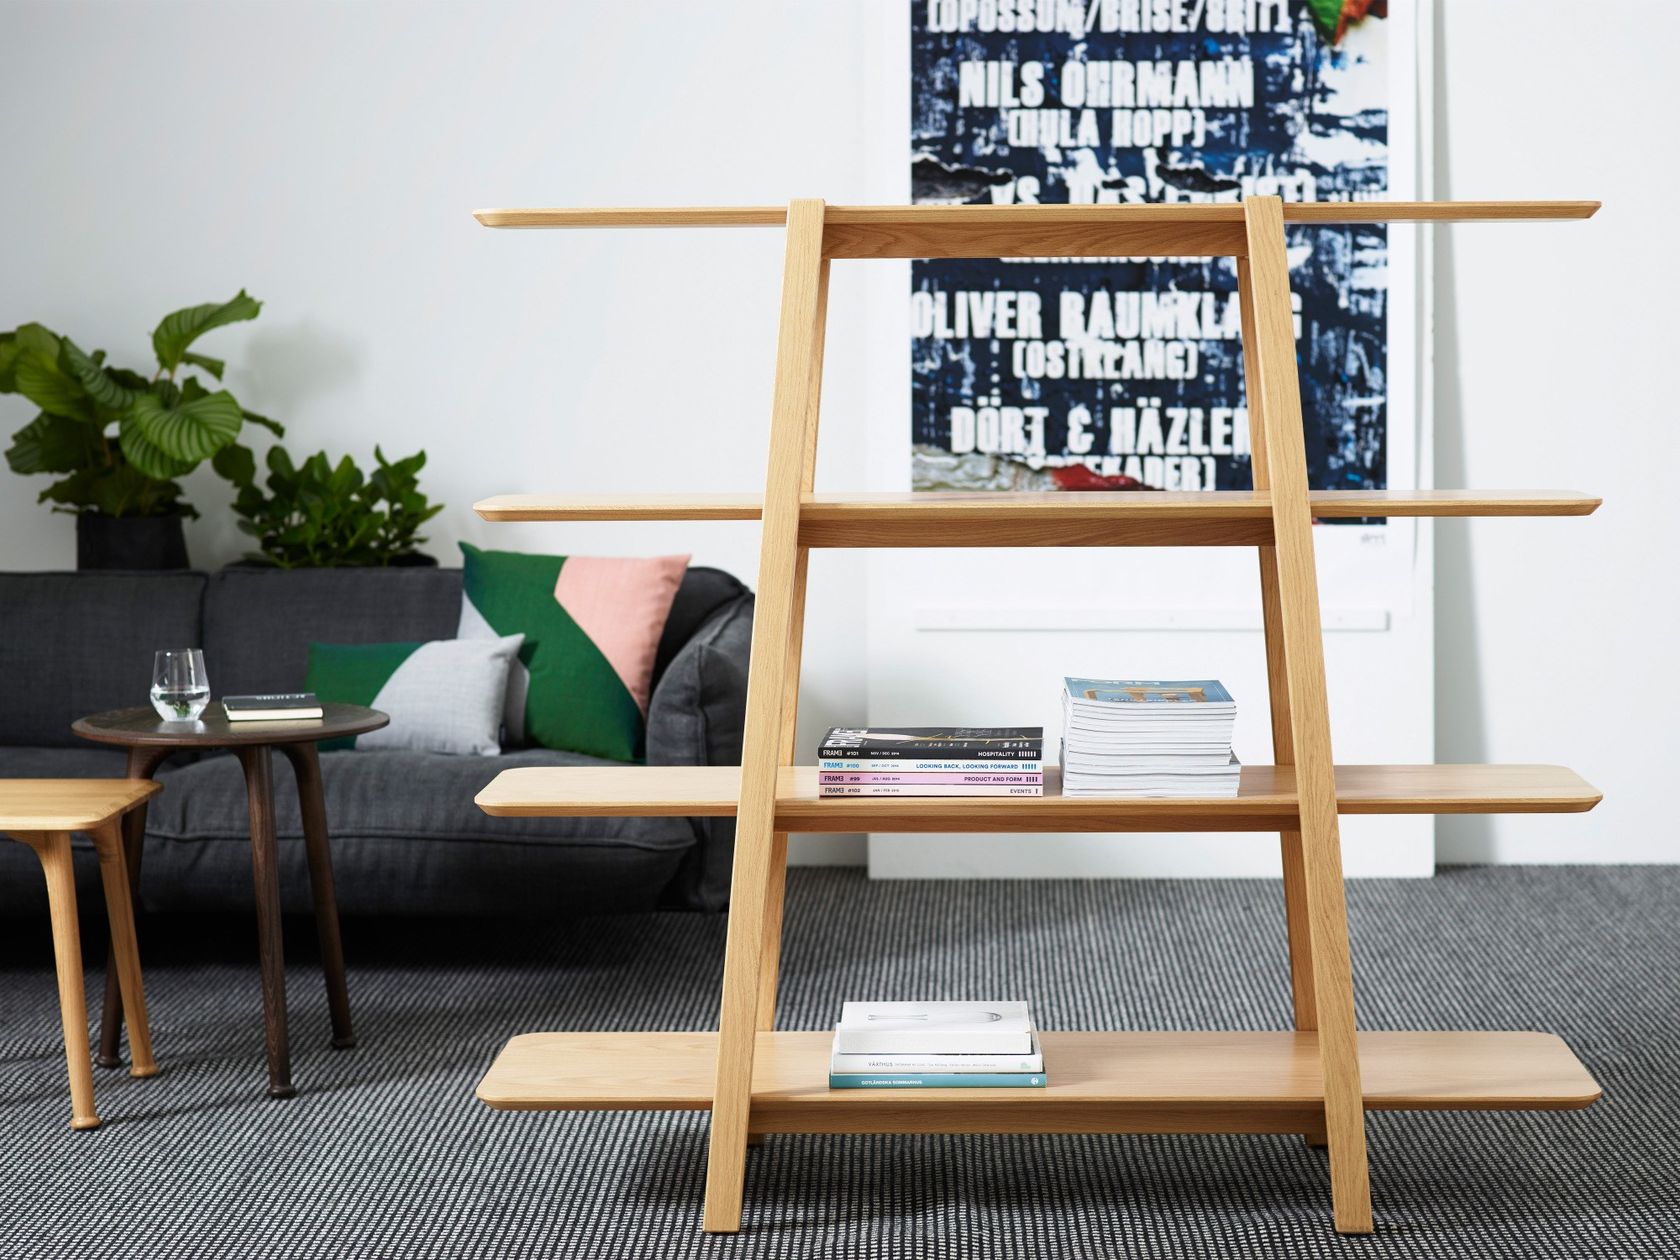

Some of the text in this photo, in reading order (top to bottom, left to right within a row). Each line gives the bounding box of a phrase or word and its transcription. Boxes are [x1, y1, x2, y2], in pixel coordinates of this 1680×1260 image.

[959, 60, 1045, 107] NILS
[911, 291, 1042, 339] OLIVER
[950, 396, 1050, 455] DÖRT
[1066, 405, 1096, 454] &
